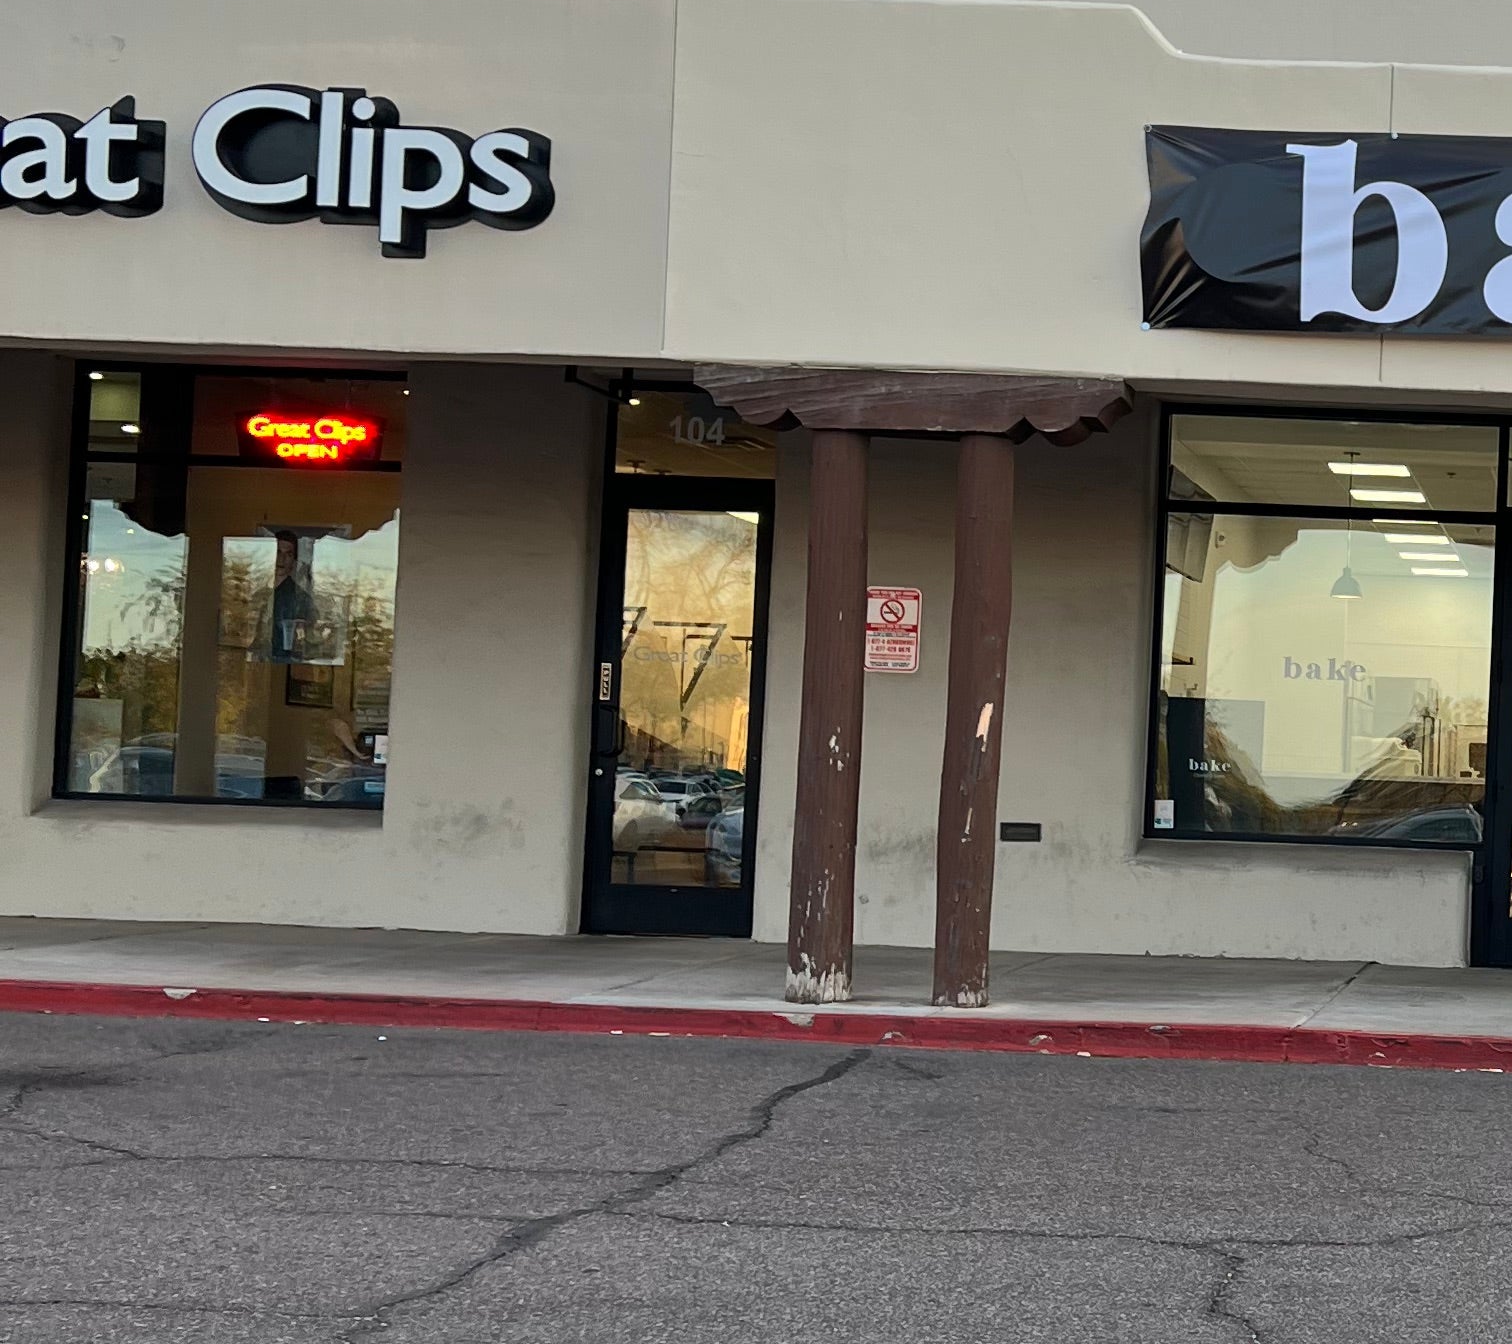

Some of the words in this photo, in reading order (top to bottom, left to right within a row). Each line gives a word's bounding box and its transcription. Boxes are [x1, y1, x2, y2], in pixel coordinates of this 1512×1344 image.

[0, 103, 148, 208] at
[192, 86, 545, 250] Clips
[669, 415, 725, 446] 104
[276, 442, 338, 459] OPEN
[1283, 656, 1367, 683] bake
[1188, 758, 1232, 772] bake
